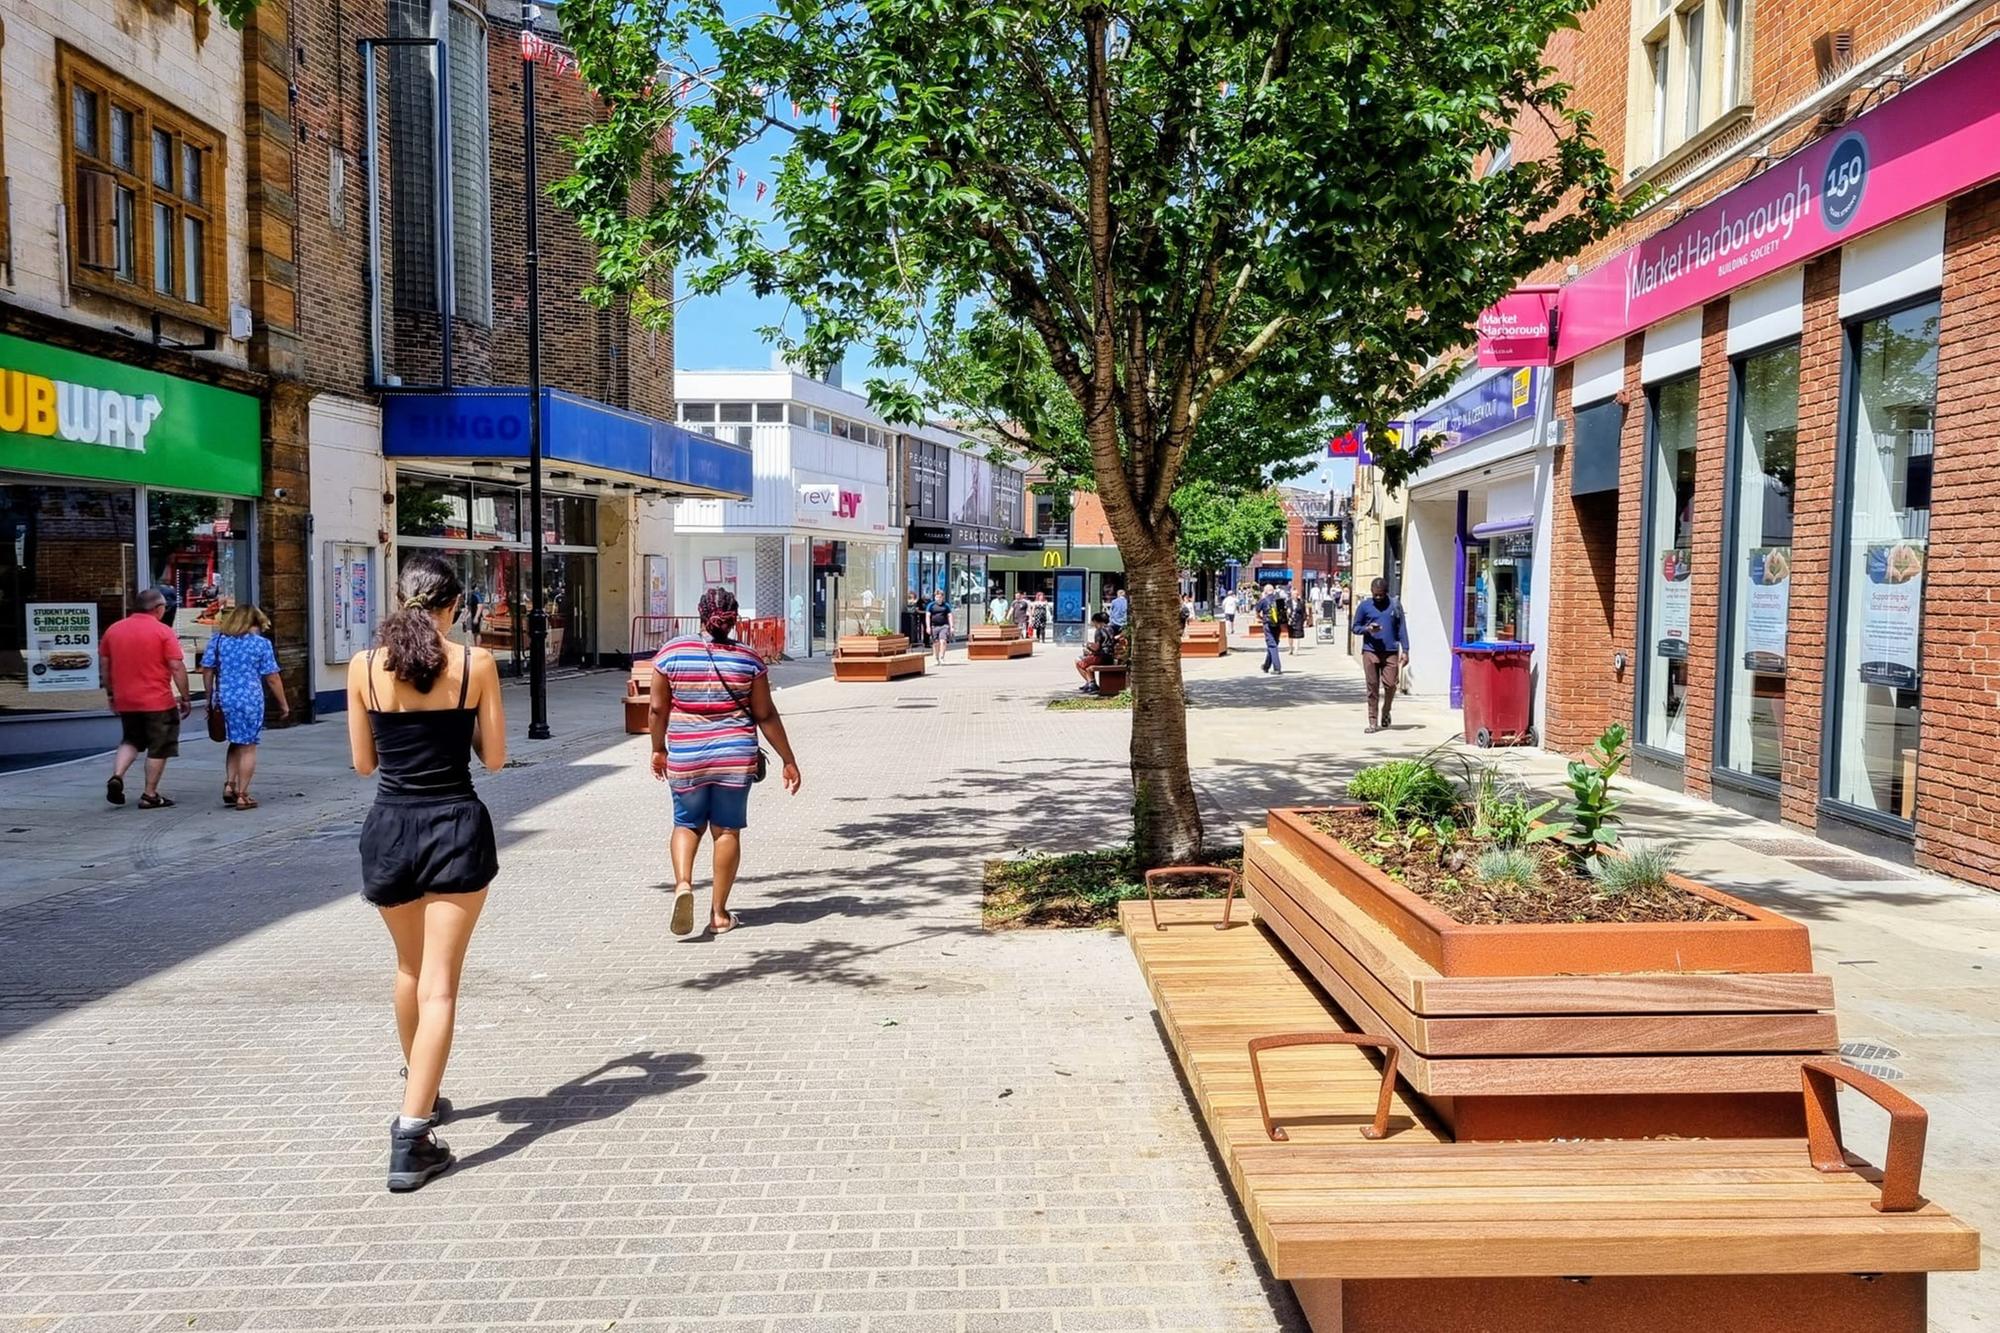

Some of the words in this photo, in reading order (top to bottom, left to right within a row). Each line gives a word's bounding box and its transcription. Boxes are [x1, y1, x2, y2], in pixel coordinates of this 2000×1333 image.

[1827, 156, 1862, 197] 150
[1631, 245, 1683, 299] Market
[1686, 167, 1811, 274] Harborough
[1718, 256, 1748, 277] BUILDING
[1750, 238, 1780, 263] SOCIETY
[1482, 314, 1517, 324] Market
[1482, 322, 1547, 337] Harborough
[409, 415, 522, 440] BINGO
[908, 452, 948, 471] PEACOCKS
[959, 529, 998, 544] PEACOCKS
[33, 608, 62, 616] STUDENT
[34, 617, 69, 626] 6-INCH
[70, 617, 91, 625] SUB
[55, 634, 90, 646] £3.50
